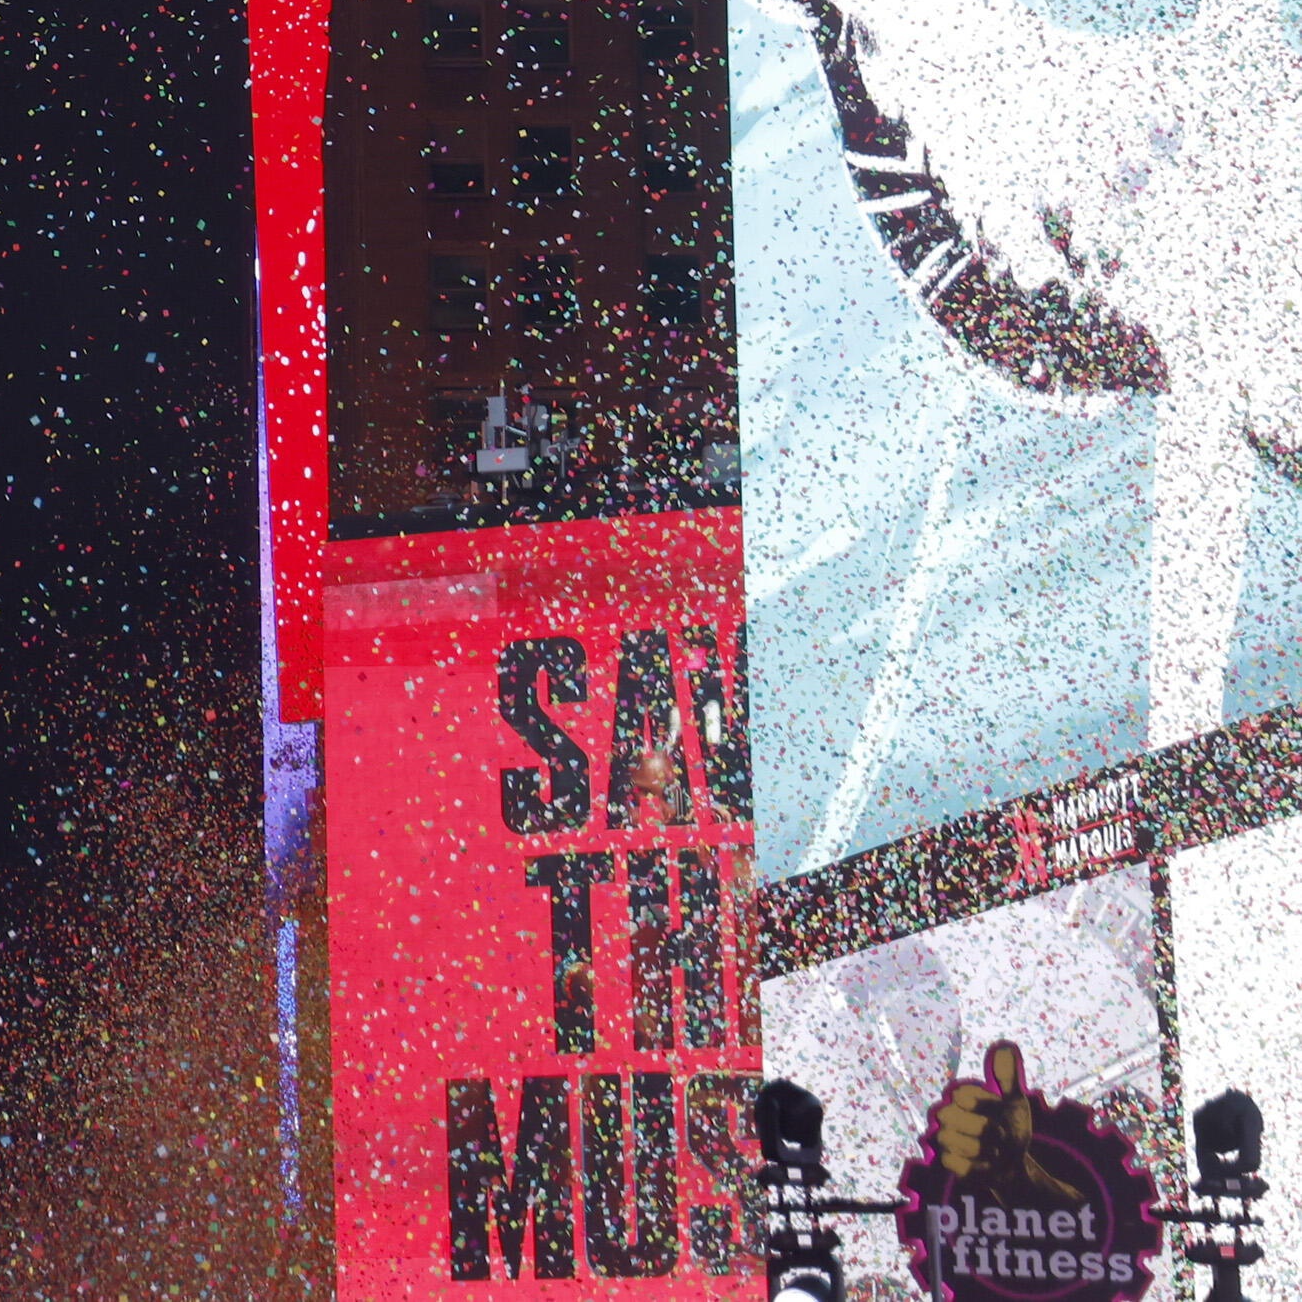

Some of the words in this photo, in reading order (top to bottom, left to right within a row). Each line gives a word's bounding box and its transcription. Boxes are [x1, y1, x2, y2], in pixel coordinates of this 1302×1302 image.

[1052, 773, 1141, 833] MARRIOTT
[1054, 818, 1134, 869] MARQUIS
[927, 1195, 1097, 1245] planet
[952, 1235, 1135, 1282] fitness
